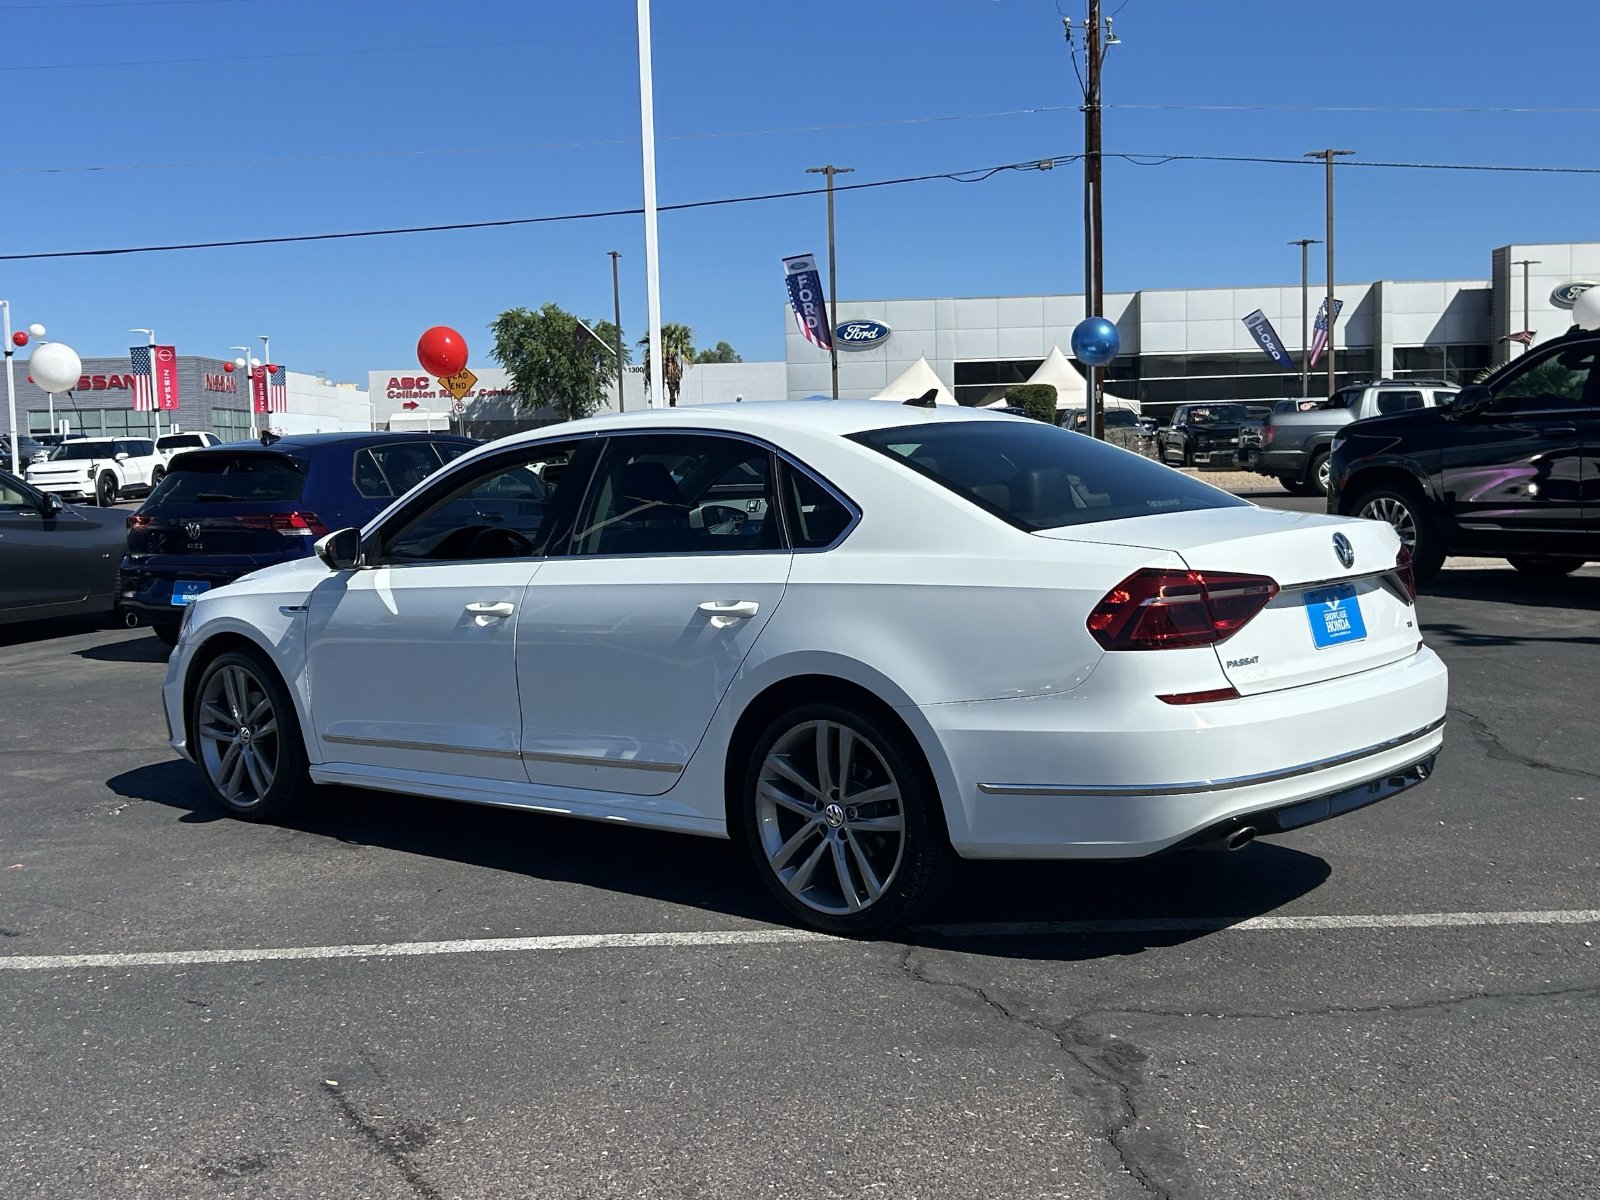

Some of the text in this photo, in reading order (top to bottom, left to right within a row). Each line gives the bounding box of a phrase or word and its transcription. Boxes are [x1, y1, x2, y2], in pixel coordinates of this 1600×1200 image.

[797, 274, 818, 329] FORD
[843, 324, 879, 340] Ford
[1255, 325, 1281, 360] FORD
[77, 374, 135, 391] SSAN
[386, 376, 430, 390] ABC
[452, 372, 468, 380] EAD
[163, 369, 172, 407] NISSAN
[387, 389, 436, 399] Collision
[450, 382, 467, 390] END
[1325, 617, 1351, 633] HONDA
[1226, 655, 1260, 669] PASSAT
